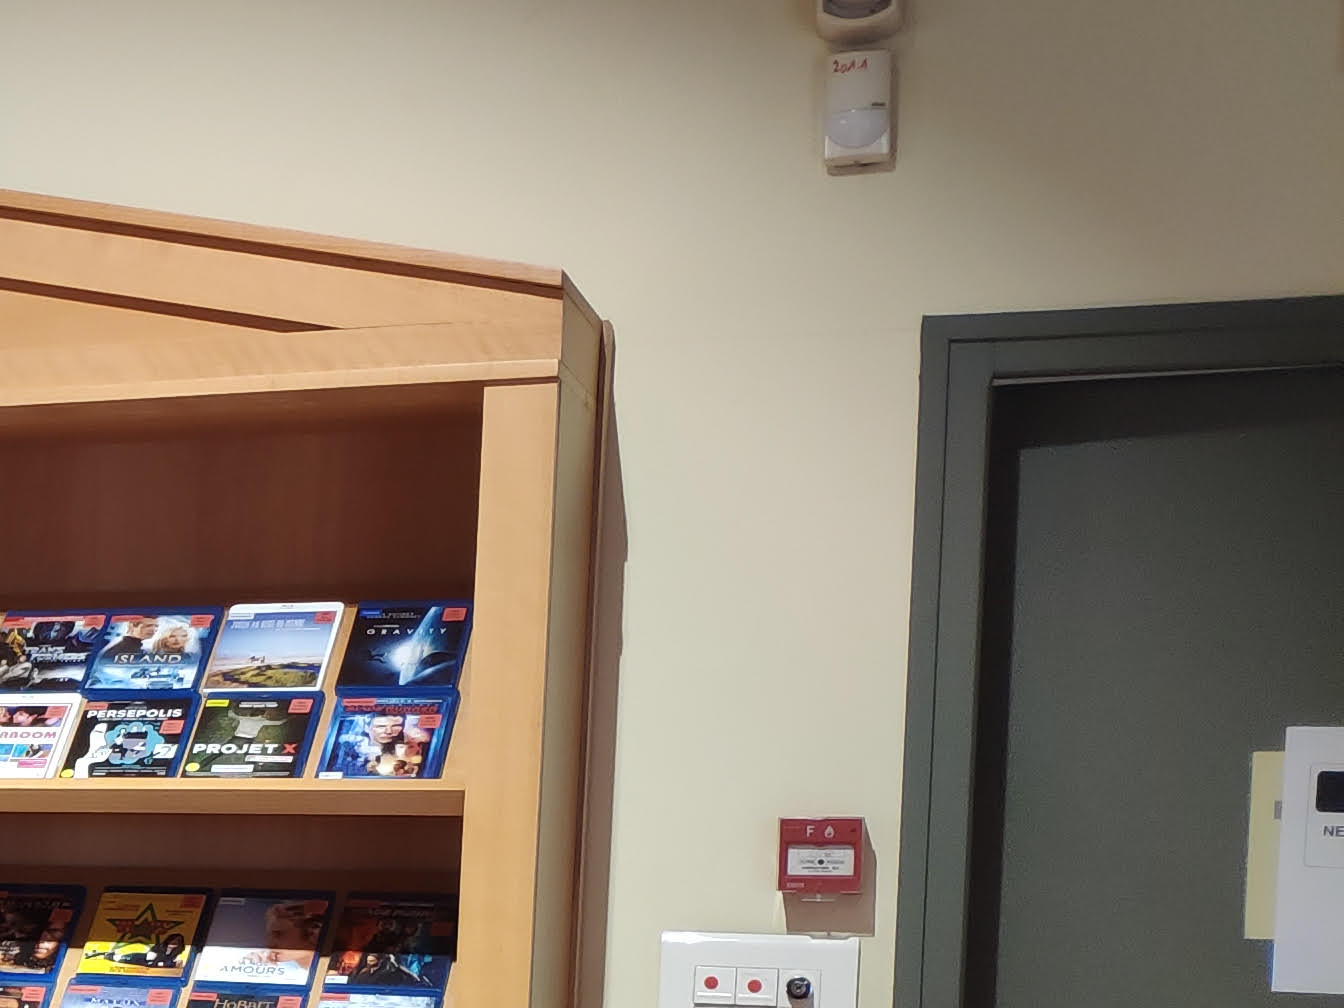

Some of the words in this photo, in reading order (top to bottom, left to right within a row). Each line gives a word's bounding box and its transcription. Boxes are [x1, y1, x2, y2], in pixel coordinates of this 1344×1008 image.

[366, 627, 447, 636] GRAVITY
[87, 708, 182, 720] PERSEPOLIS
[192, 743, 279, 755] PROJET
[282, 743, 297, 755] X
[806, 826, 815, 837] F
[220, 965, 285, 975] AMOURS
